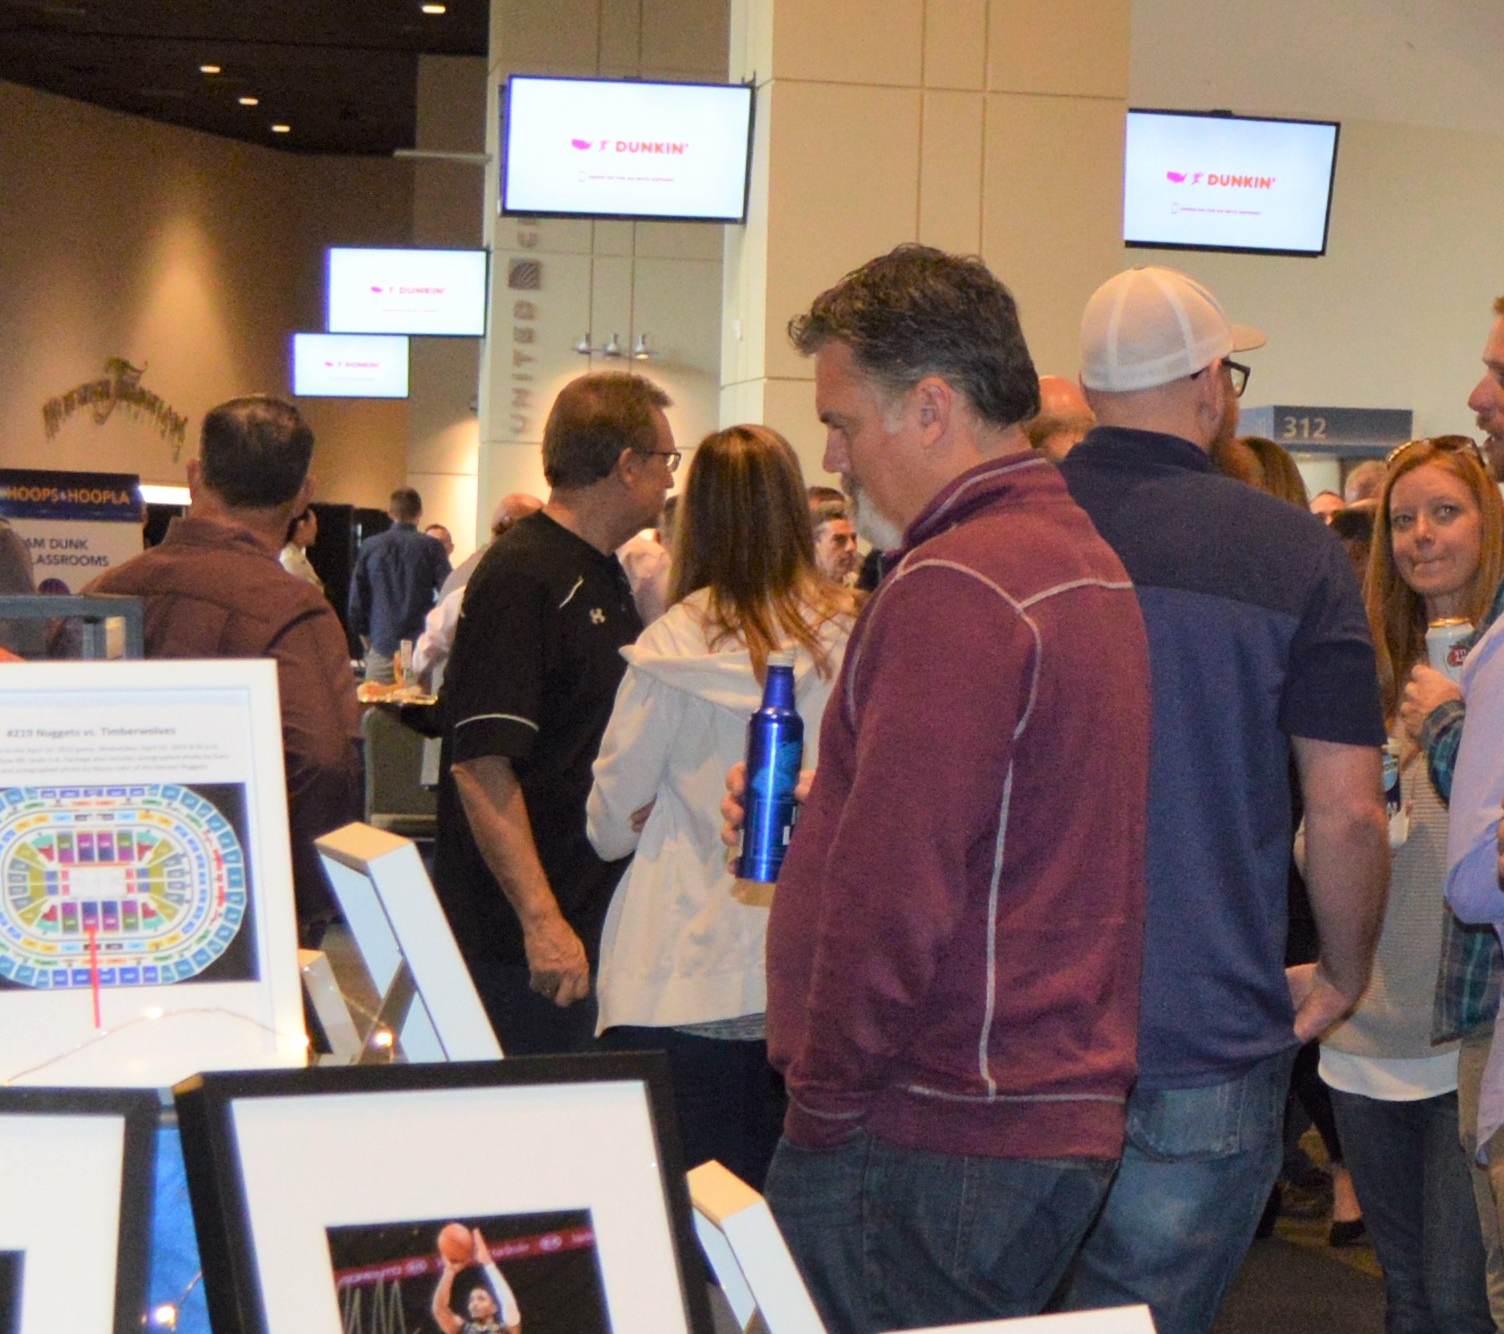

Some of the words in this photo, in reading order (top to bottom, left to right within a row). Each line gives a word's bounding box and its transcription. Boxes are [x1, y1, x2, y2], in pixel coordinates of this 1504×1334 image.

[615, 140, 688, 155] DUNKIN'
[1207, 173, 1276, 189] DUNKIN'
[1283, 416, 1327, 440] 312
[6, 485, 59, 504] HOOPS
[67, 489, 131, 506] HOOPLA
[49, 538, 88, 550] DUNK
[32, 554, 109, 567] ASSROOMS
